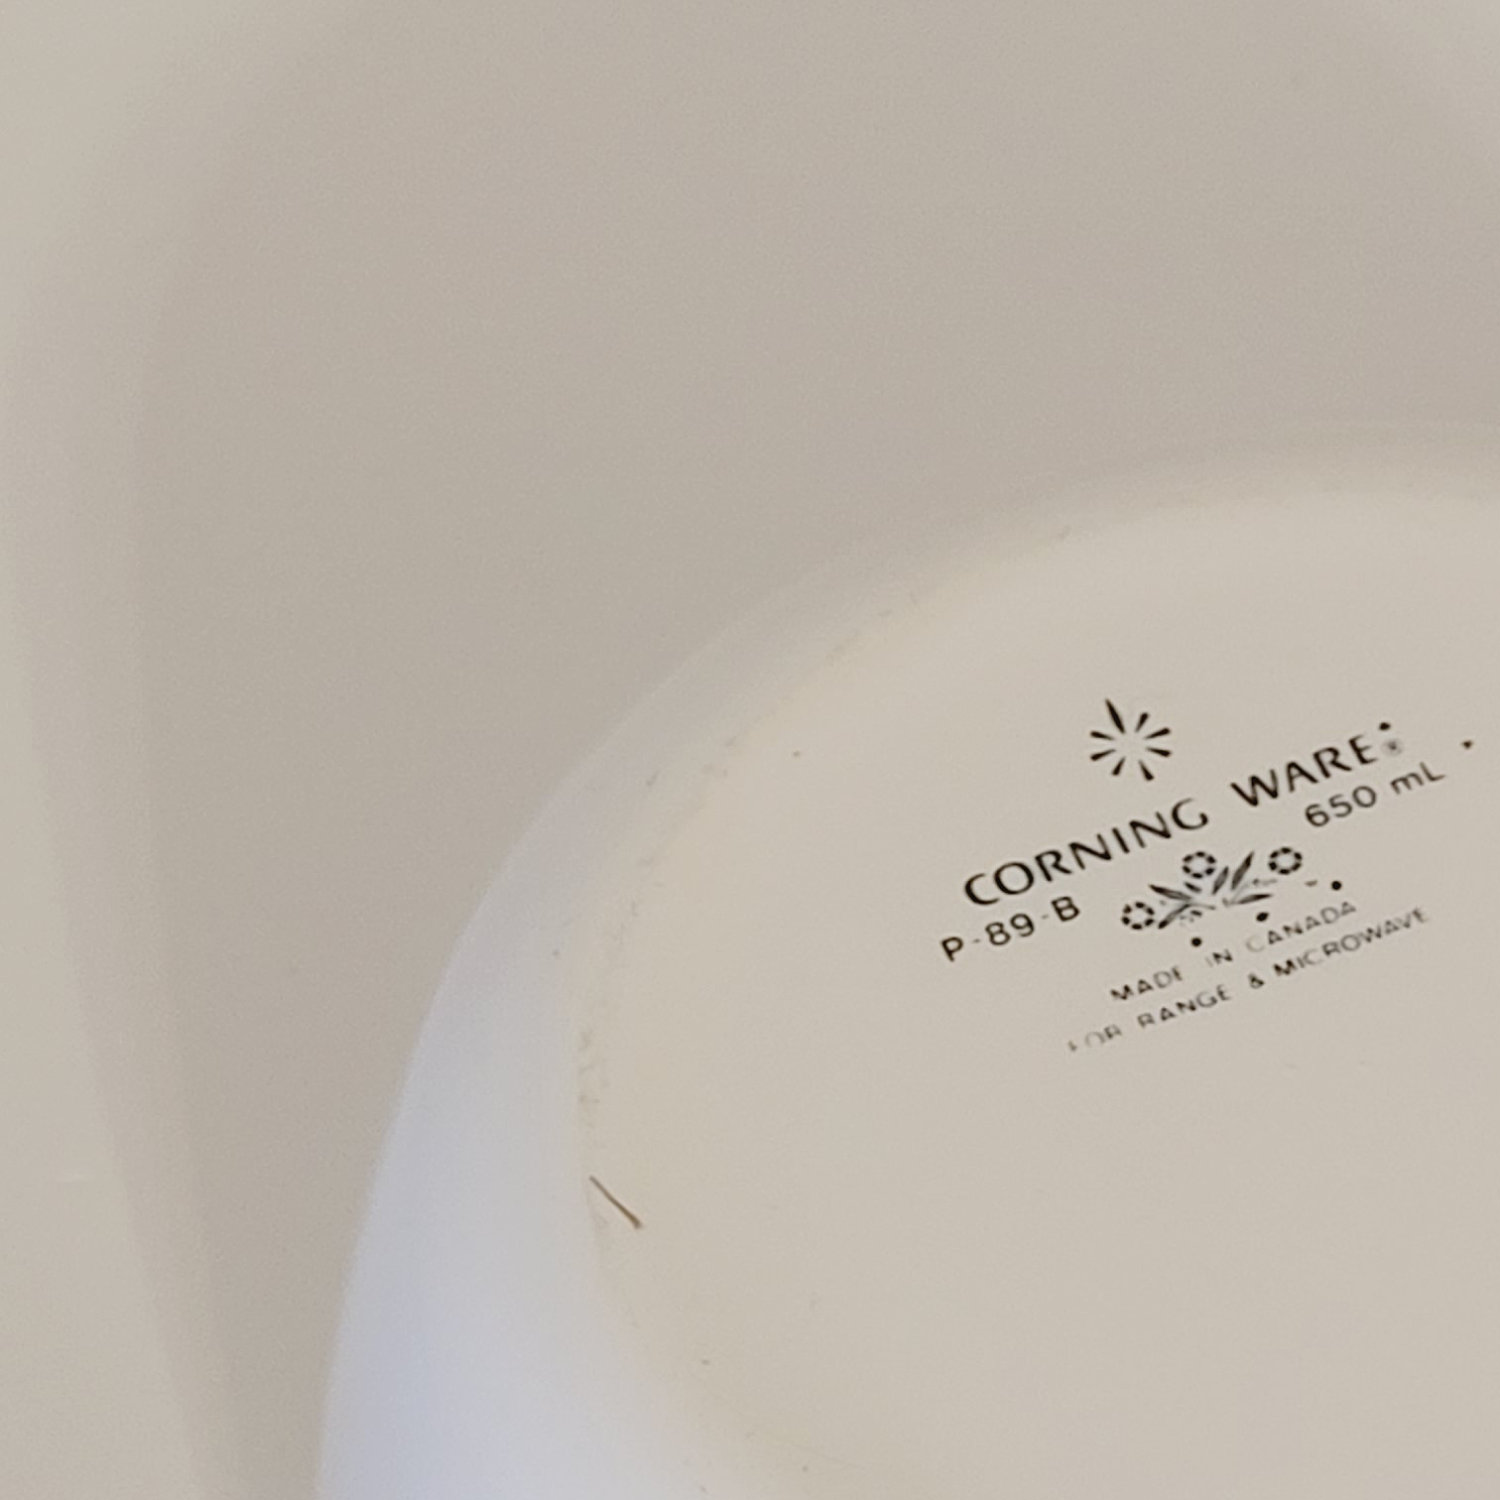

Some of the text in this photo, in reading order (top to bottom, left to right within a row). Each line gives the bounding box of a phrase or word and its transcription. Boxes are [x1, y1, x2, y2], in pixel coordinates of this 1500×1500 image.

[941, 762, 1446, 963] P-89-B 650 mL
[963, 798, 1209, 906] CORNING
[1136, 984, 1232, 1029] RANGE
[1247, 971, 1265, 990] &
[1273, 906, 1431, 978] MICROWAVE
[1245, 900, 1357, 953] CANADA
